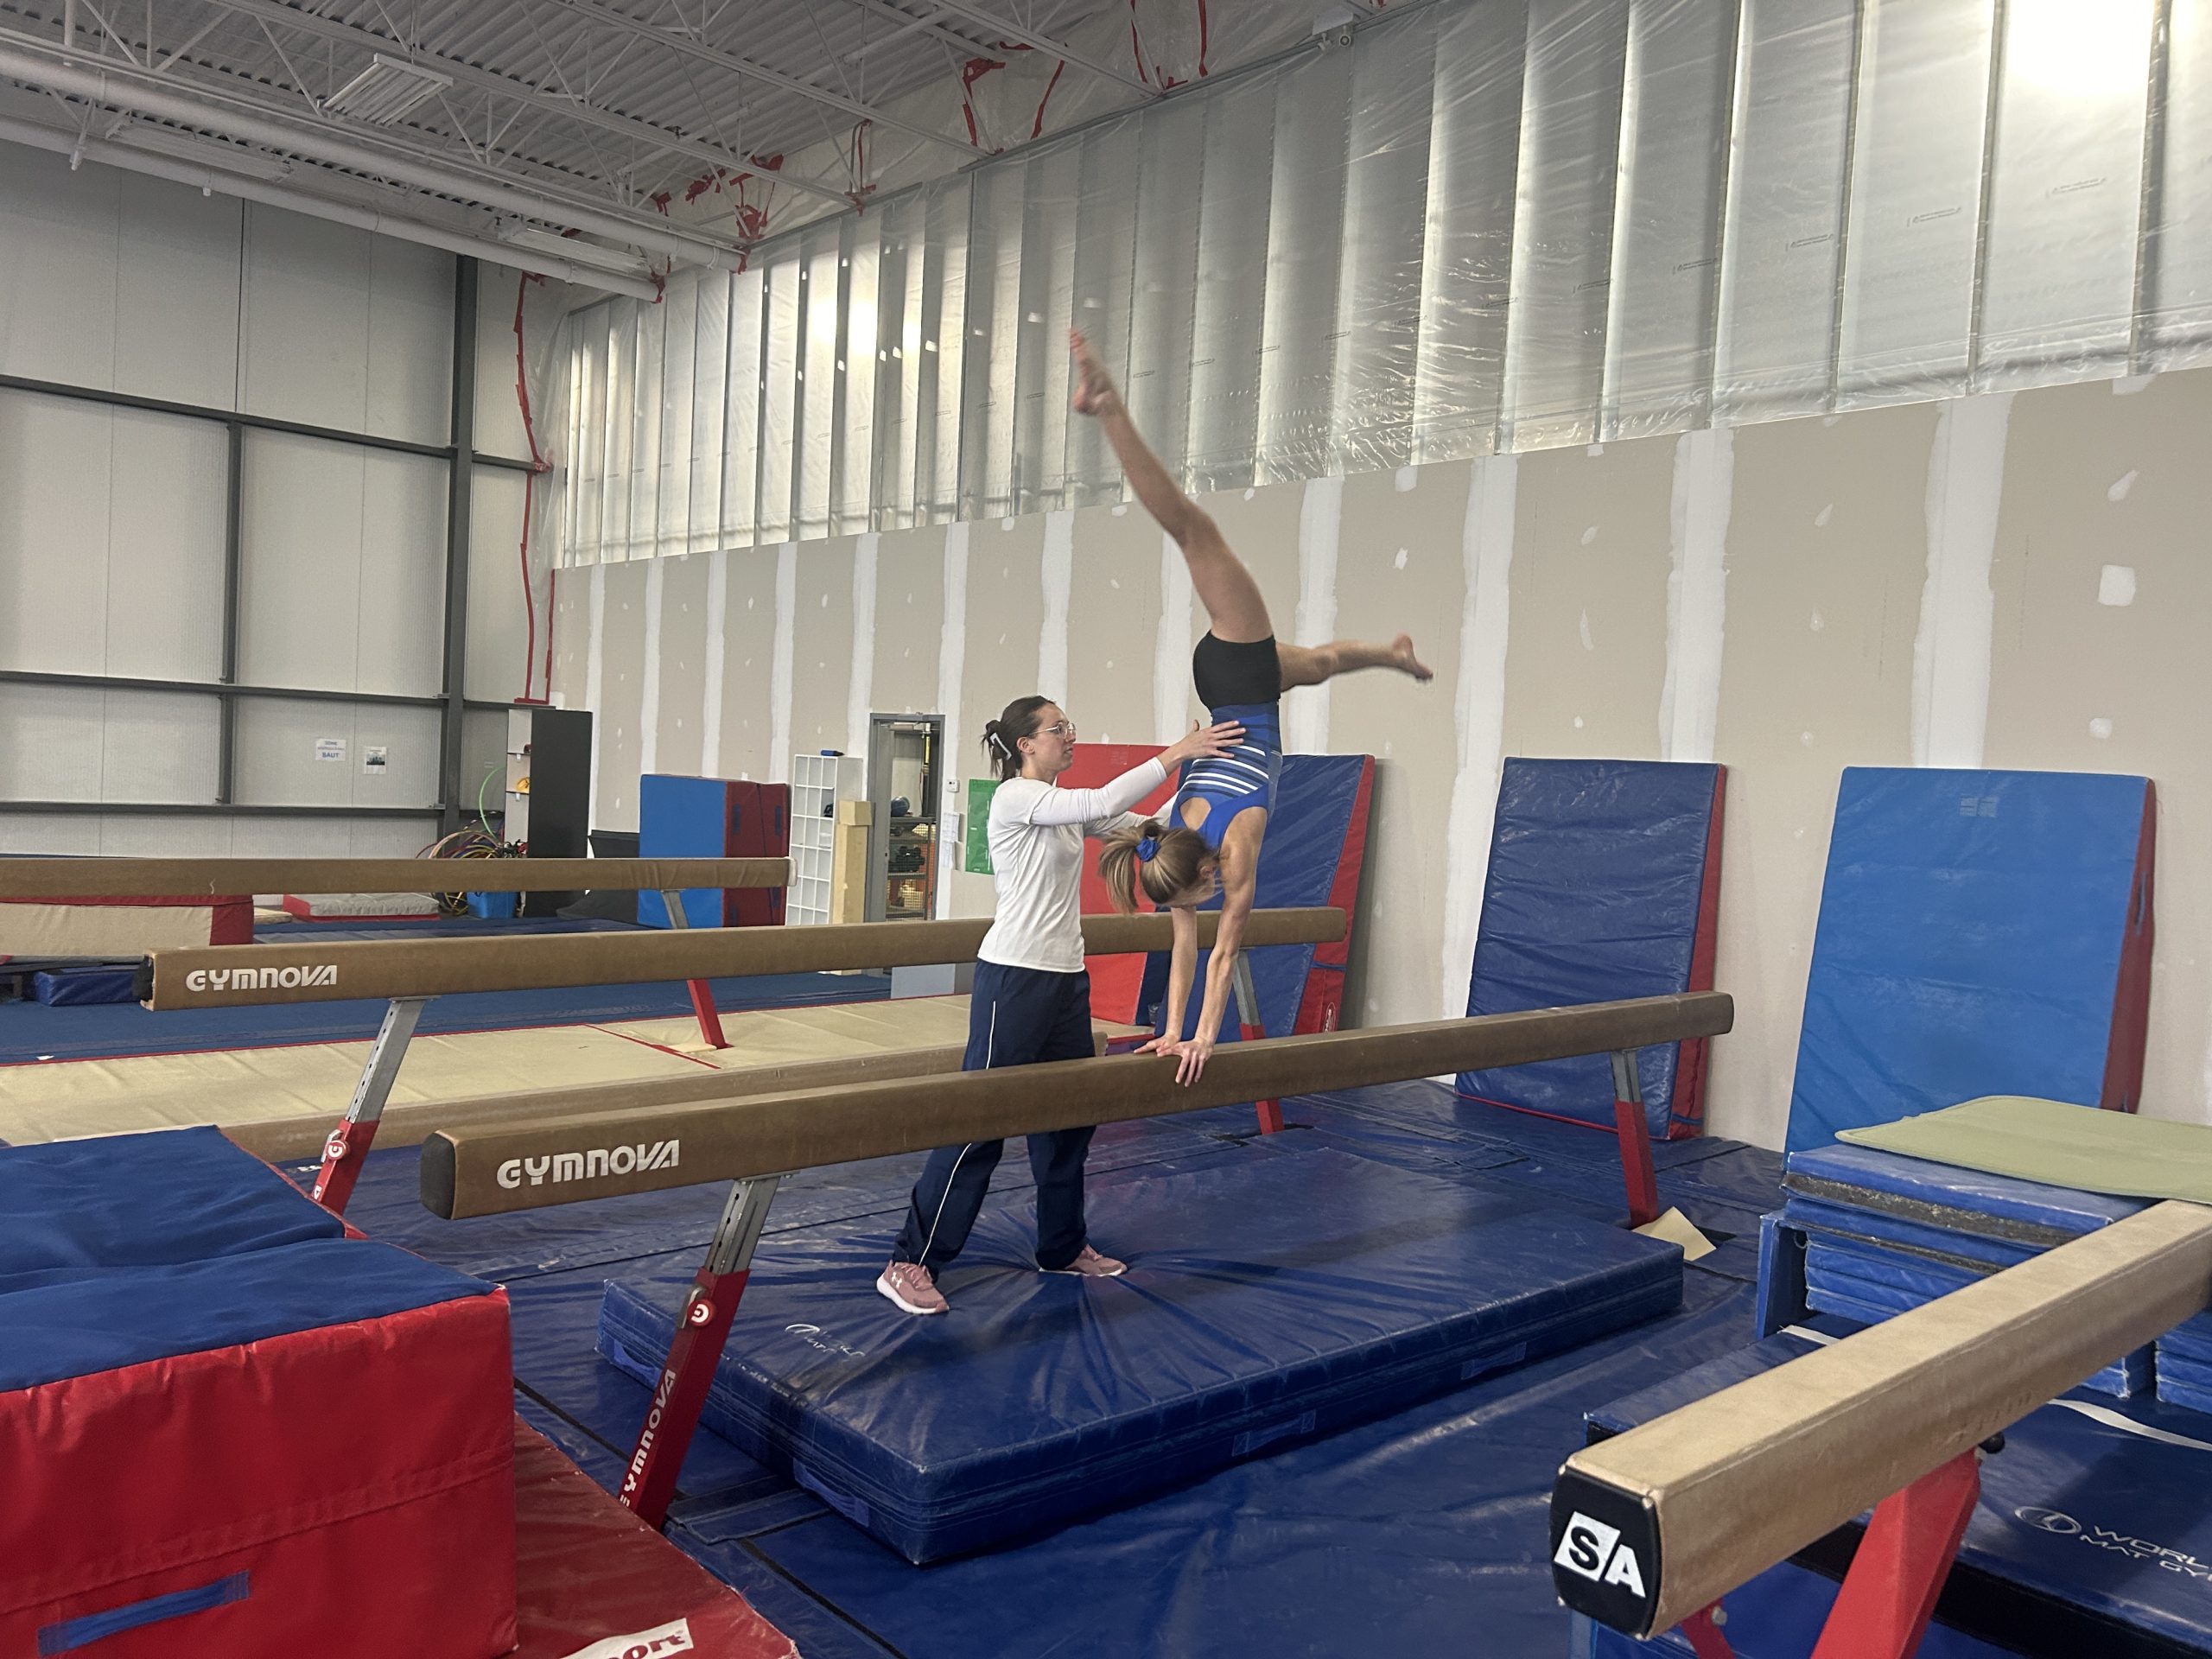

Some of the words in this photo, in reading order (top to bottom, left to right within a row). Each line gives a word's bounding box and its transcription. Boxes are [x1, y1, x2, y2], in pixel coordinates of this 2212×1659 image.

[186, 965, 337, 992] GYMNOVA
[497, 1140, 679, 1189] GYMNOVA
[2094, 1525, 2212, 1570] WORL
[2159, 1560, 2212, 1583] GY
[607, 1634, 685, 1659] ort
